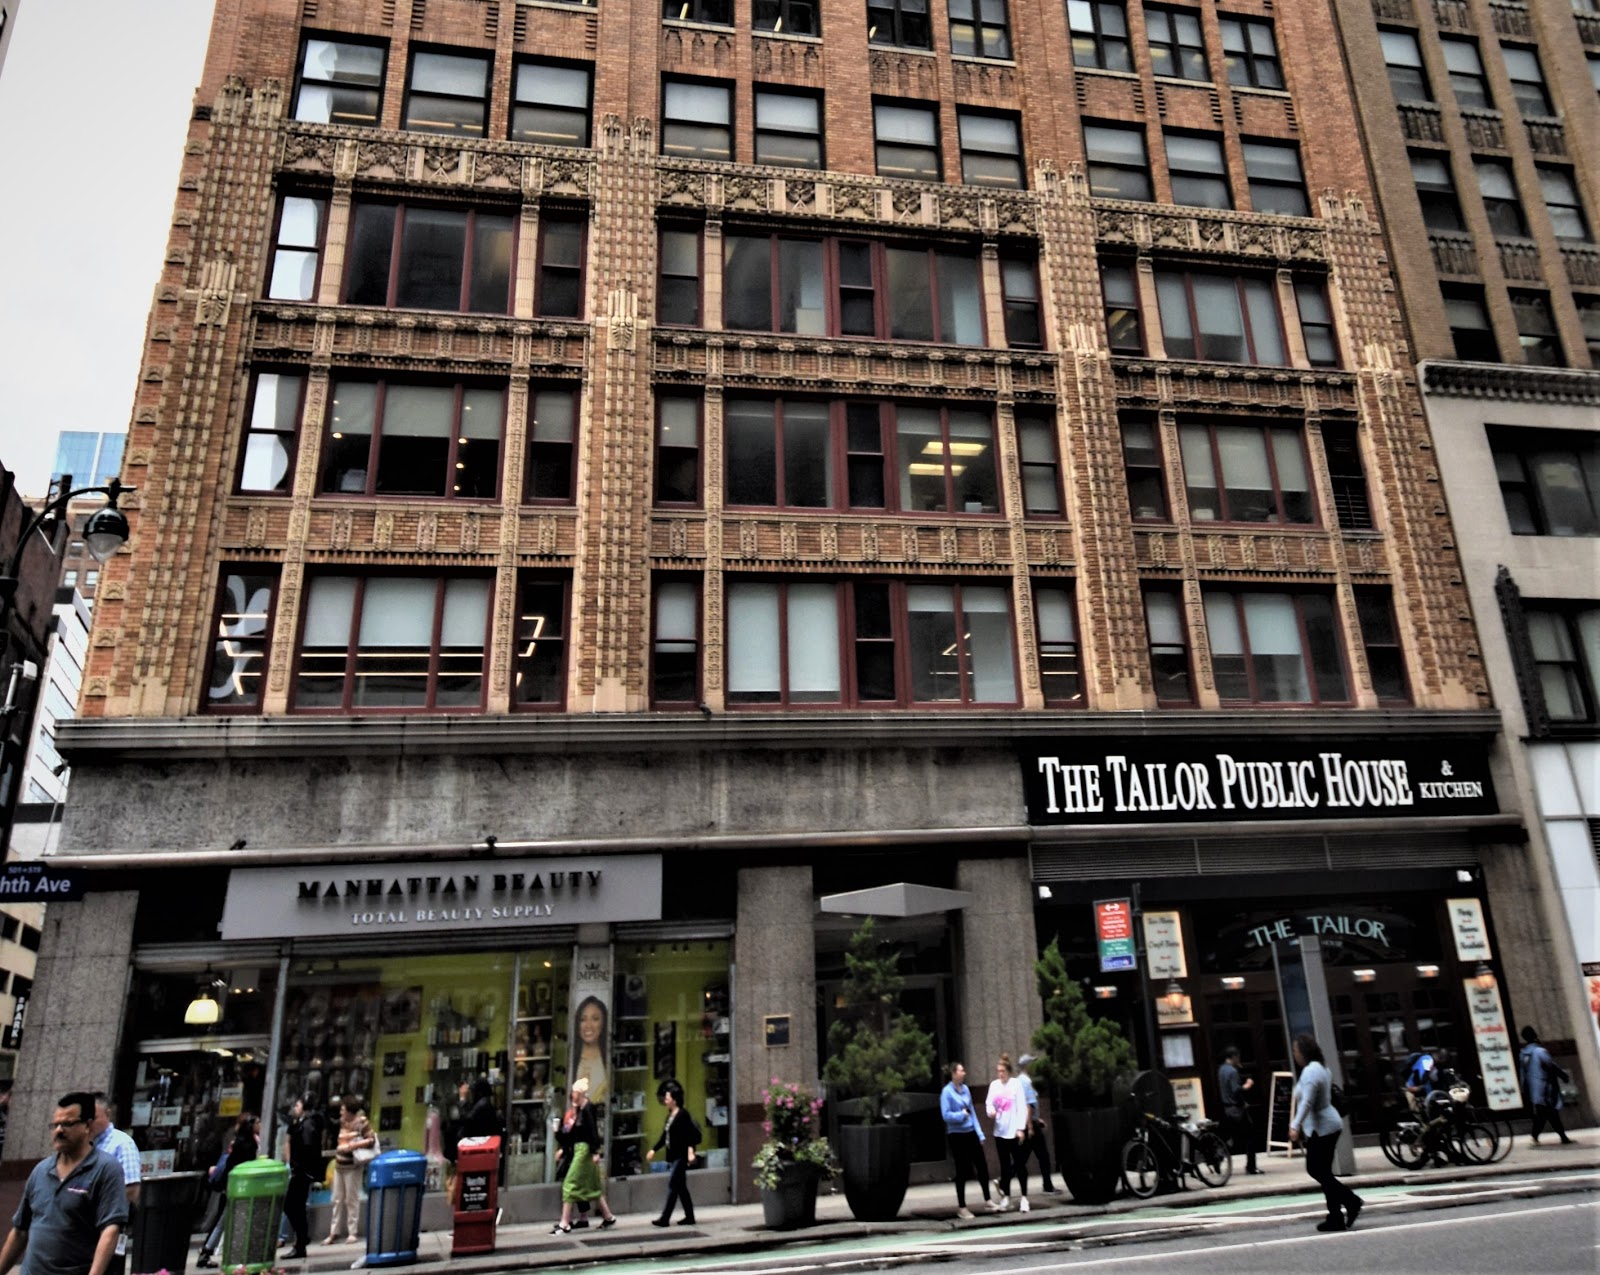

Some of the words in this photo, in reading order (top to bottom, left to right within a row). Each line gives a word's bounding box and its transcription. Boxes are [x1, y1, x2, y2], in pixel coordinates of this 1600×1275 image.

[1440, 760, 1455, 777] &
[1038, 756, 1104, 814] THE
[1106, 755, 1217, 812] TAILOR
[1216, 753, 1319, 809] PUBLIC
[1319, 752, 1413, 807] HOUSE
[1419, 781, 1484, 800] KITCHEN
[34, 875, 71, 893] Ave
[297, 874, 480, 899] MANHATTAN
[493, 870, 604, 893] BEAUTY
[351, 910, 408, 926] TOTAL
[416, 907, 487, 923] BEAUTY
[492, 904, 556, 920] SUPPLY
[1247, 918, 1296, 947] THE
[1306, 915, 1390, 948] TAILOR
